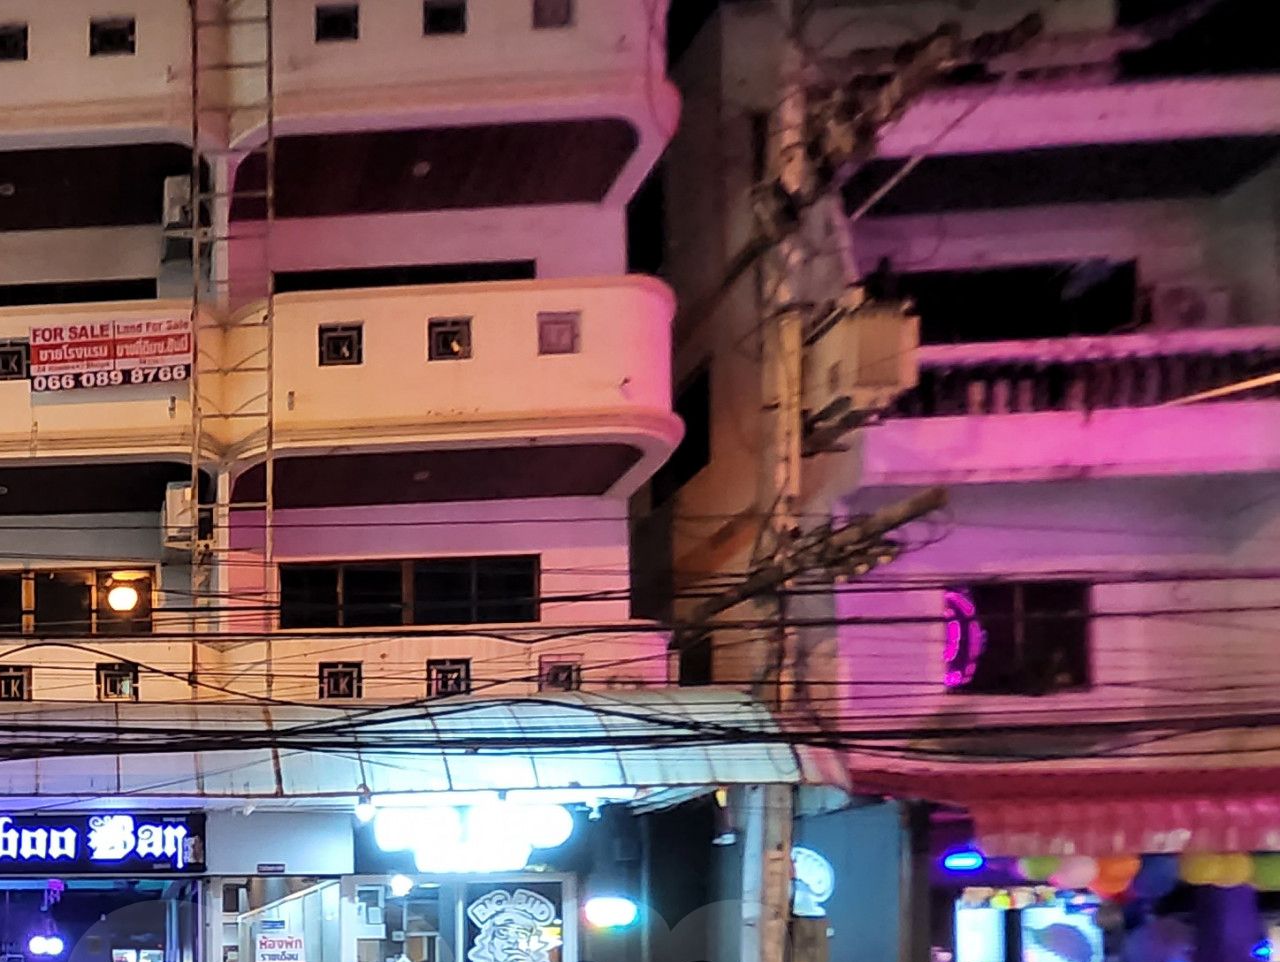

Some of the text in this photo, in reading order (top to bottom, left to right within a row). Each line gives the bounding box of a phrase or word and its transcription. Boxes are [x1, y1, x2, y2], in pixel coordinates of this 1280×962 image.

[31, 323, 110, 342] FOR SALE
[32, 366, 187, 391] 066 089 8766
[87, 814, 189, 869] Bar
[259, 935, 303, 950] ห้องพัก
